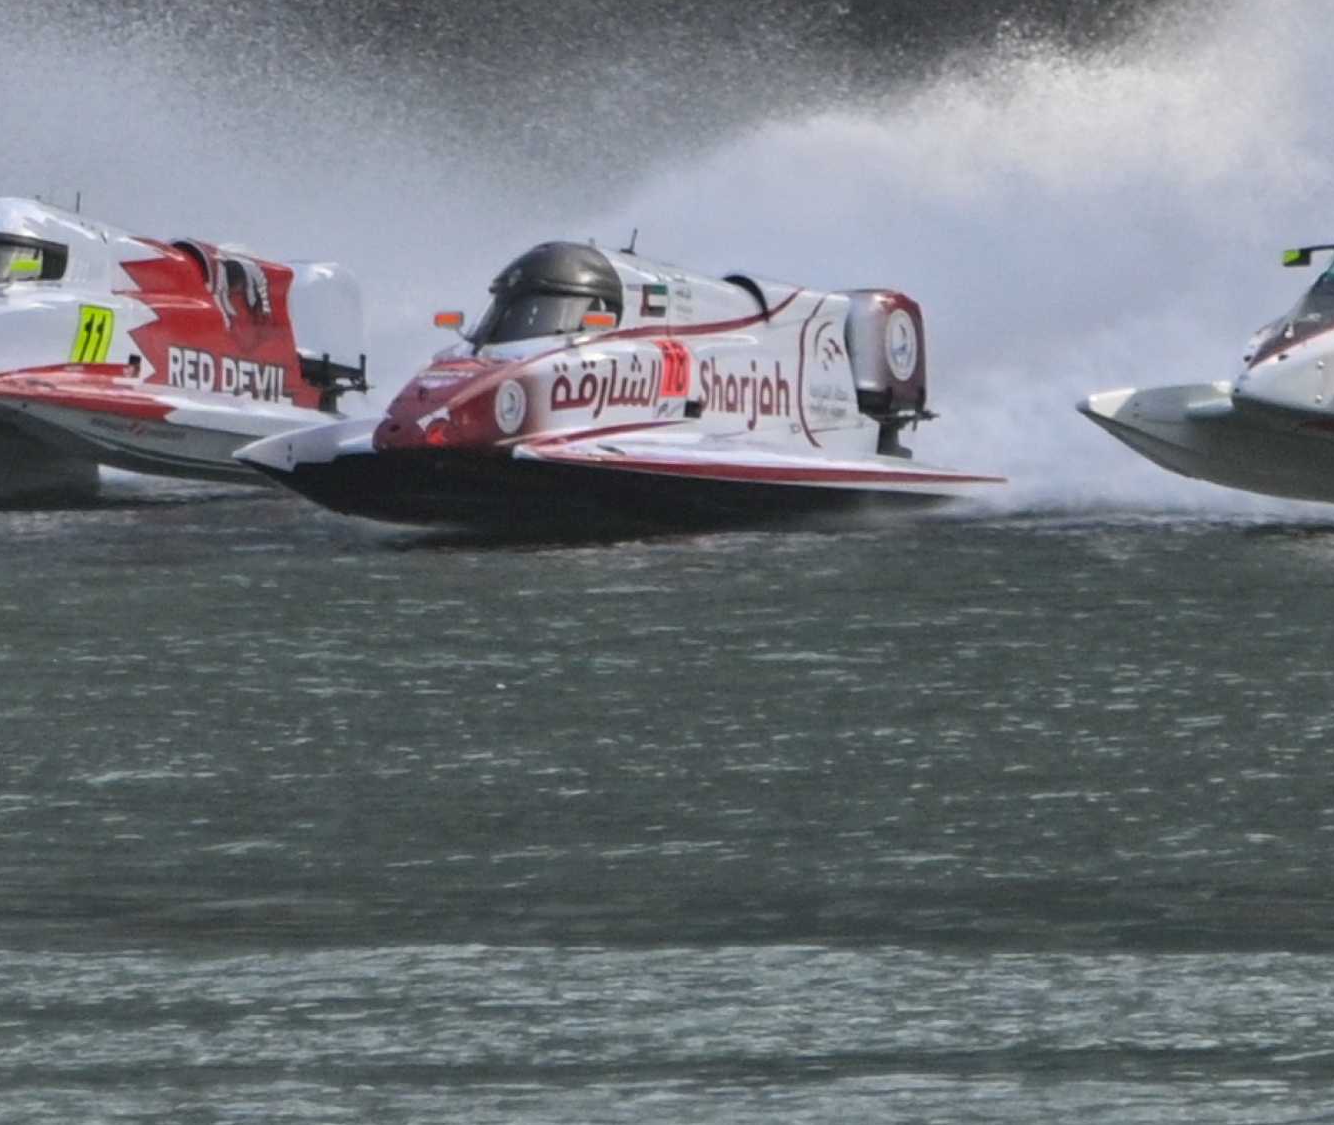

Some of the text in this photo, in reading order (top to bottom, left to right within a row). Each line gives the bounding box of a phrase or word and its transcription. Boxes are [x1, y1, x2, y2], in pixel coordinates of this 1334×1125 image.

[78, 312, 108, 364] 11
[167, 345, 294, 404] RED DEVIL
[550, 355, 662, 419] الشارقة
[699, 356, 791, 431] Sharjah
